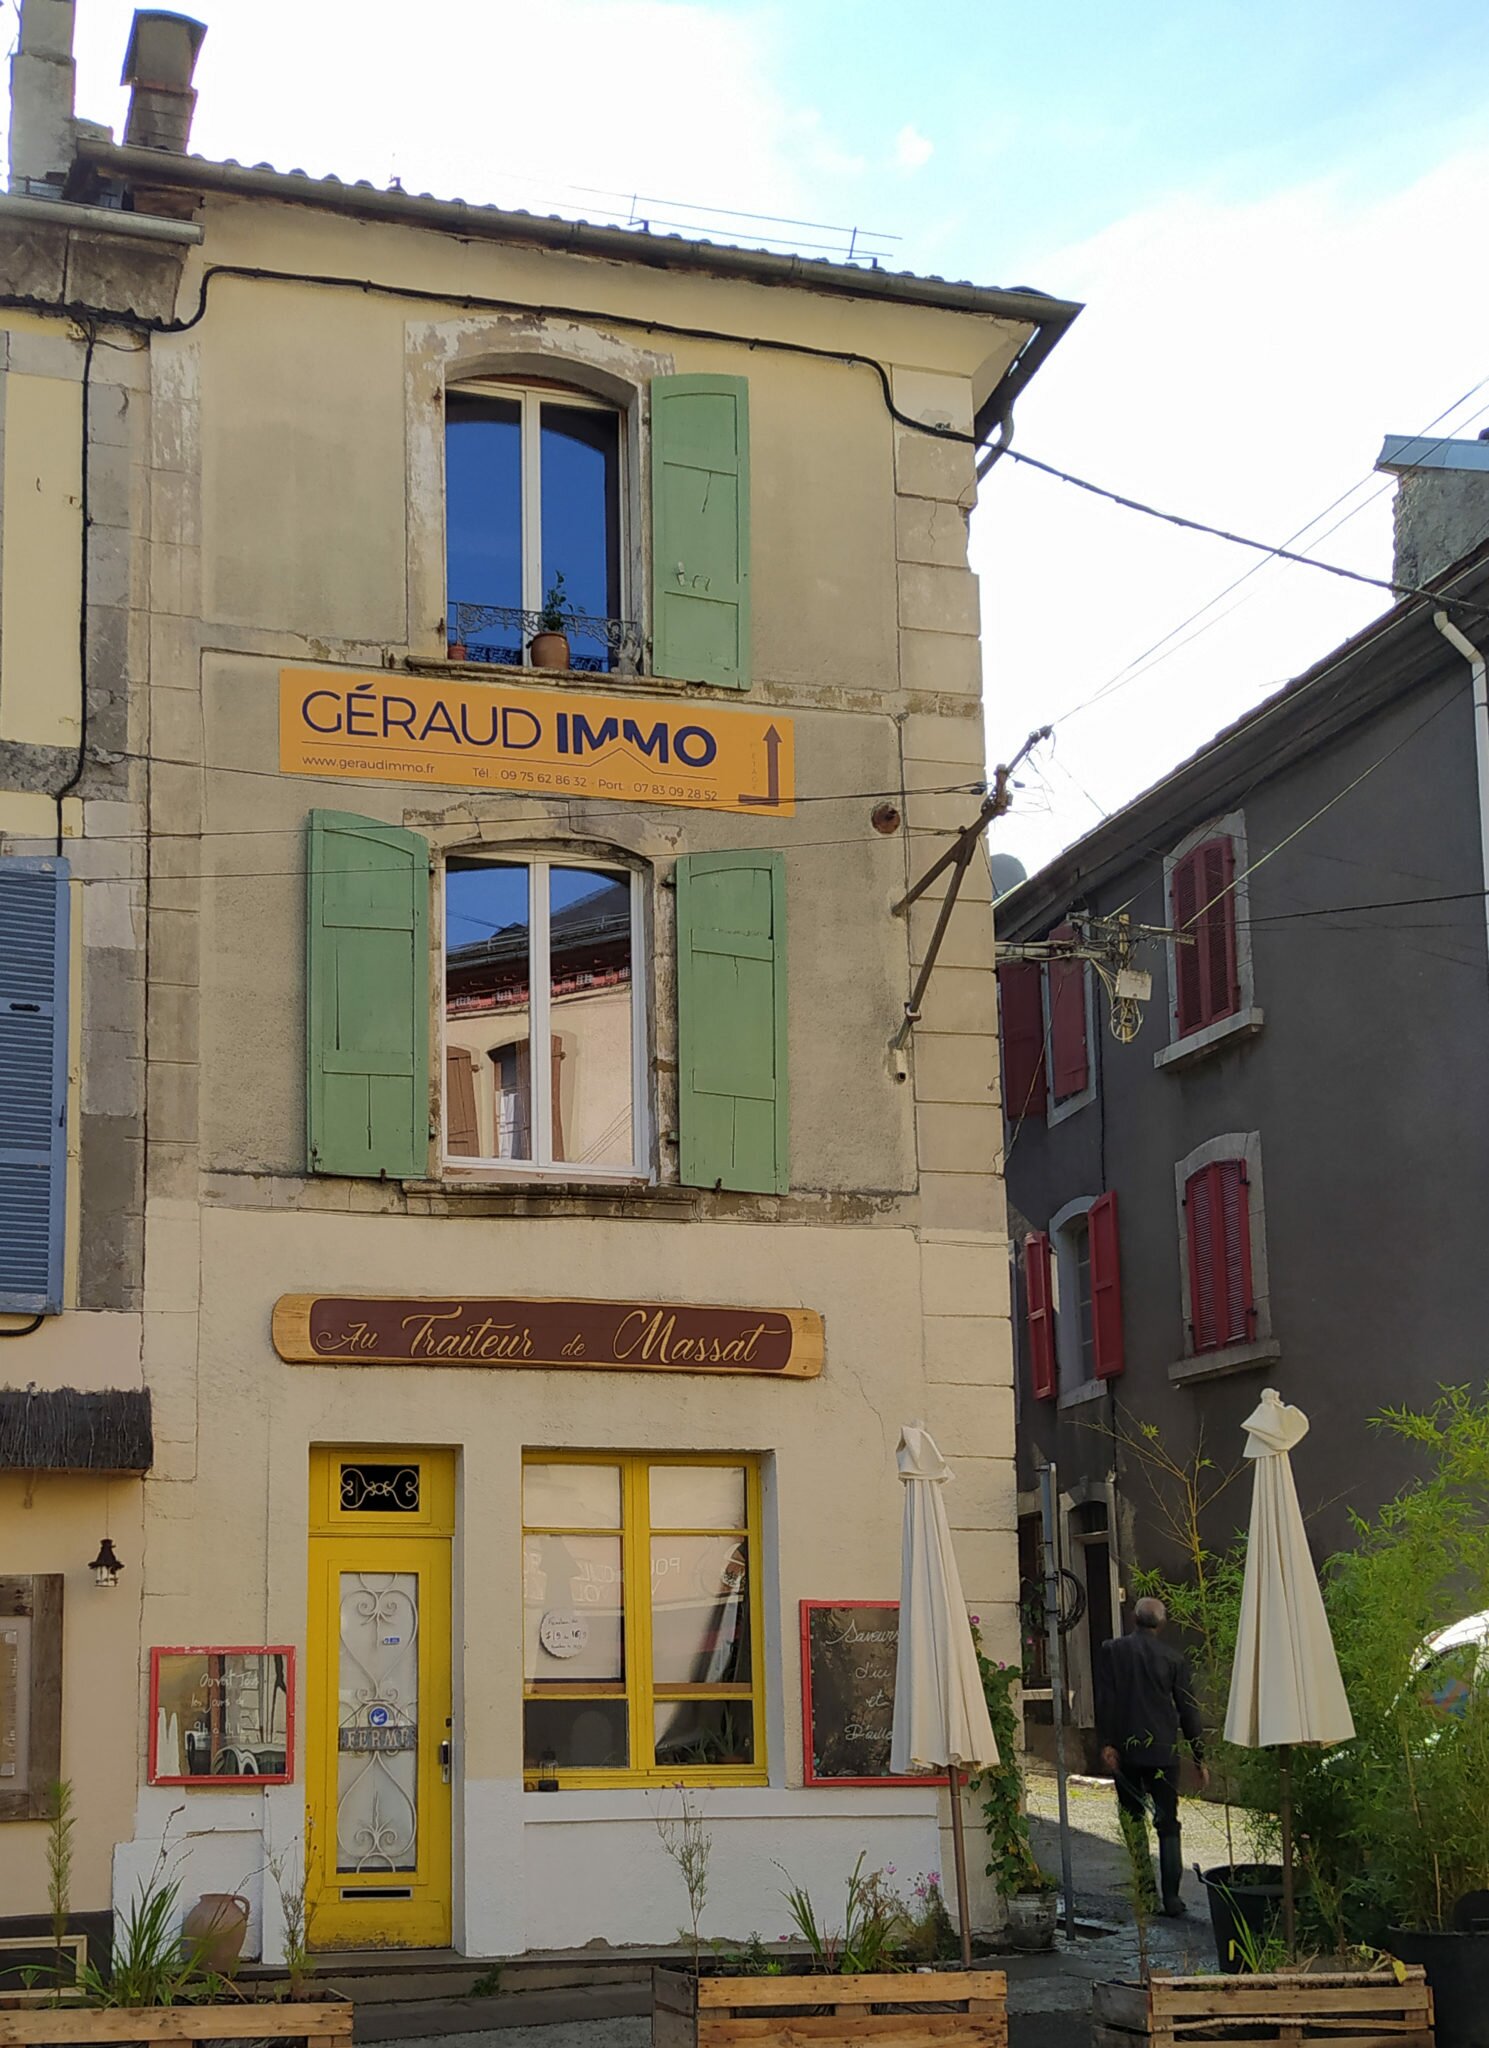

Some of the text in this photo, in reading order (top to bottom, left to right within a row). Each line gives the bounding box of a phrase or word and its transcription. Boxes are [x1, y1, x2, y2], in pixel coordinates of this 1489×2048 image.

[302, 683, 718, 768] GÉRAUD IMMO
[302, 756, 435, 774] www.geraudimmo.fr
[500, 769, 517, 780] 09
[520, 771, 534, 782] 75
[537, 773, 552, 784] 62
[556, 775, 571, 786] 86
[574, 776, 587, 788] 32
[633, 782, 648, 794] 07
[651, 784, 666, 795] 83
[668, 786, 684, 797] 09
[687, 788, 701, 799] 28
[703, 789, 717, 800] 52
[315, 1305, 787, 1364] Au Traiteur de Massat
[866, 1689, 890, 1708] et
